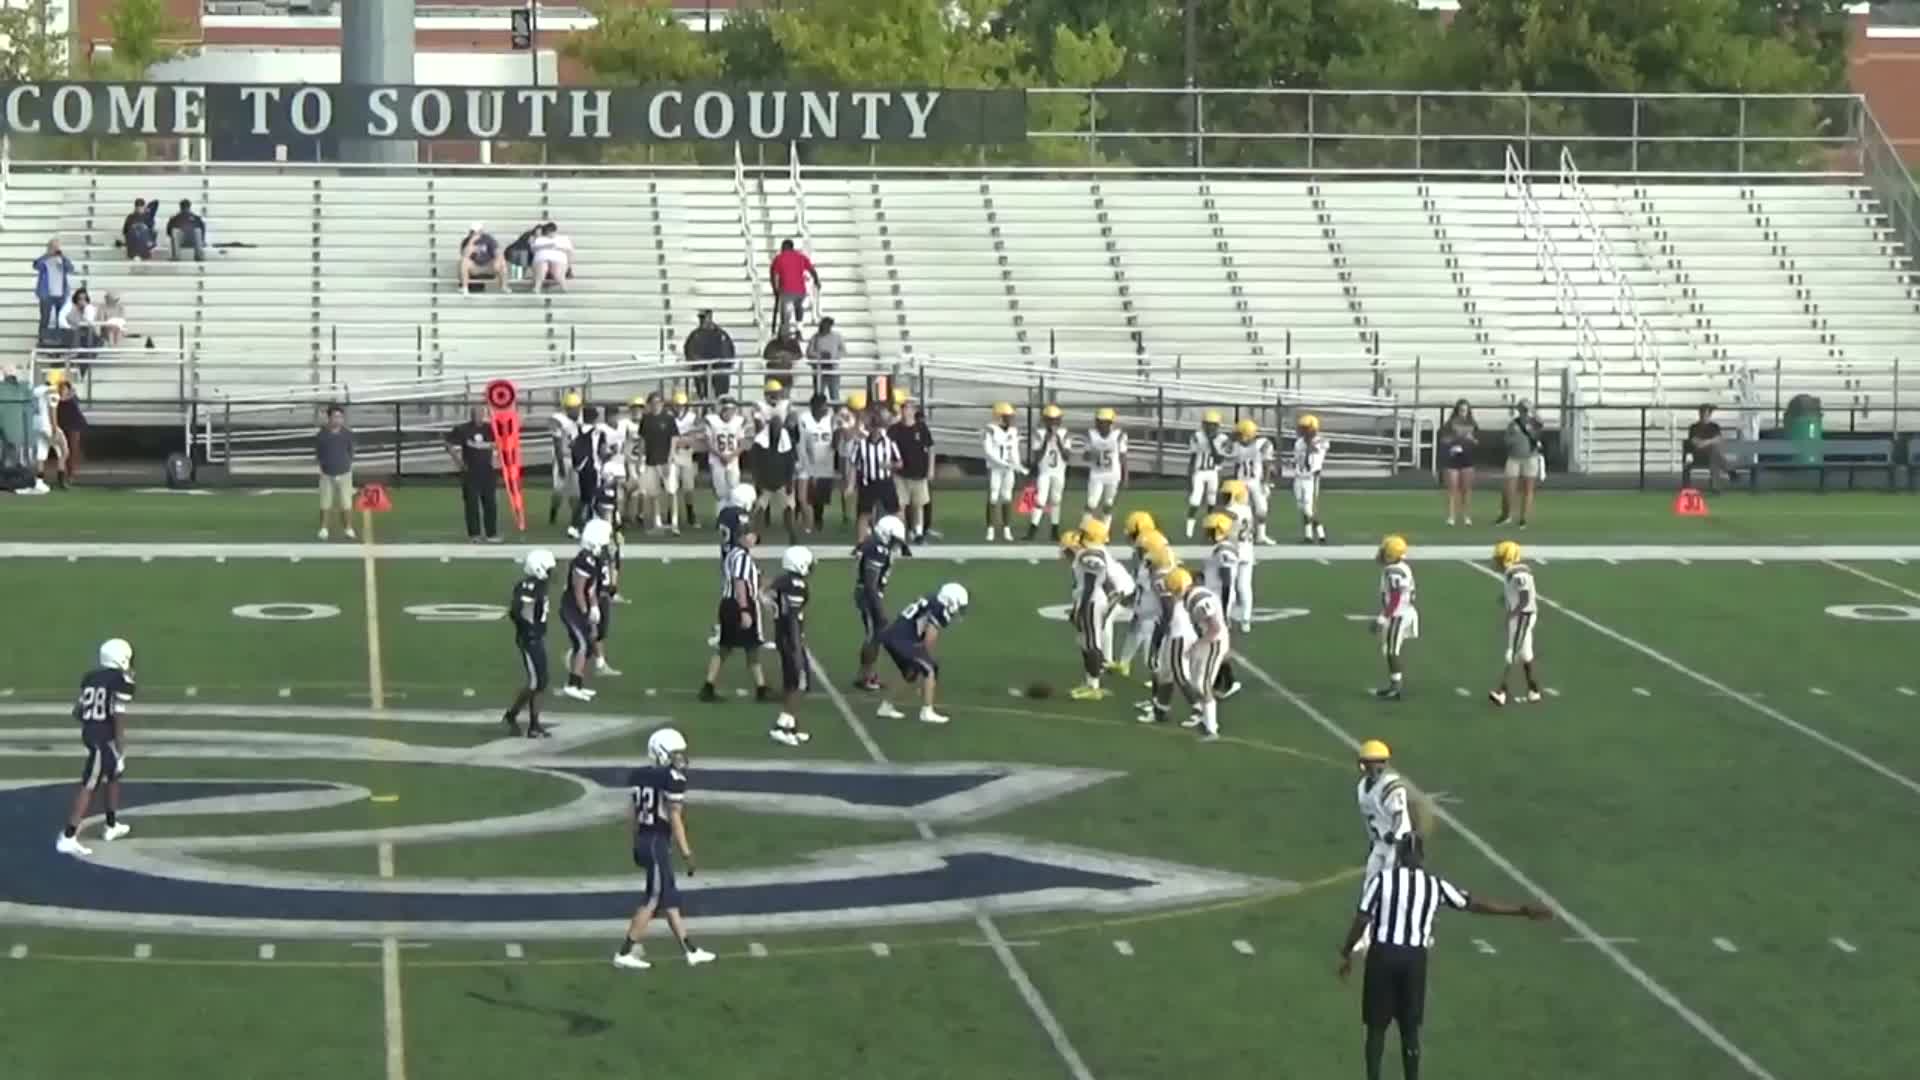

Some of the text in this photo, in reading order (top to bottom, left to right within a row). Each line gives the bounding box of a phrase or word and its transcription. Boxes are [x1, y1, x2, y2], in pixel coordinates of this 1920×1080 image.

[6, 84, 940, 139] COME TO SOUTH COUNTY
[82, 687, 107, 720] 28
